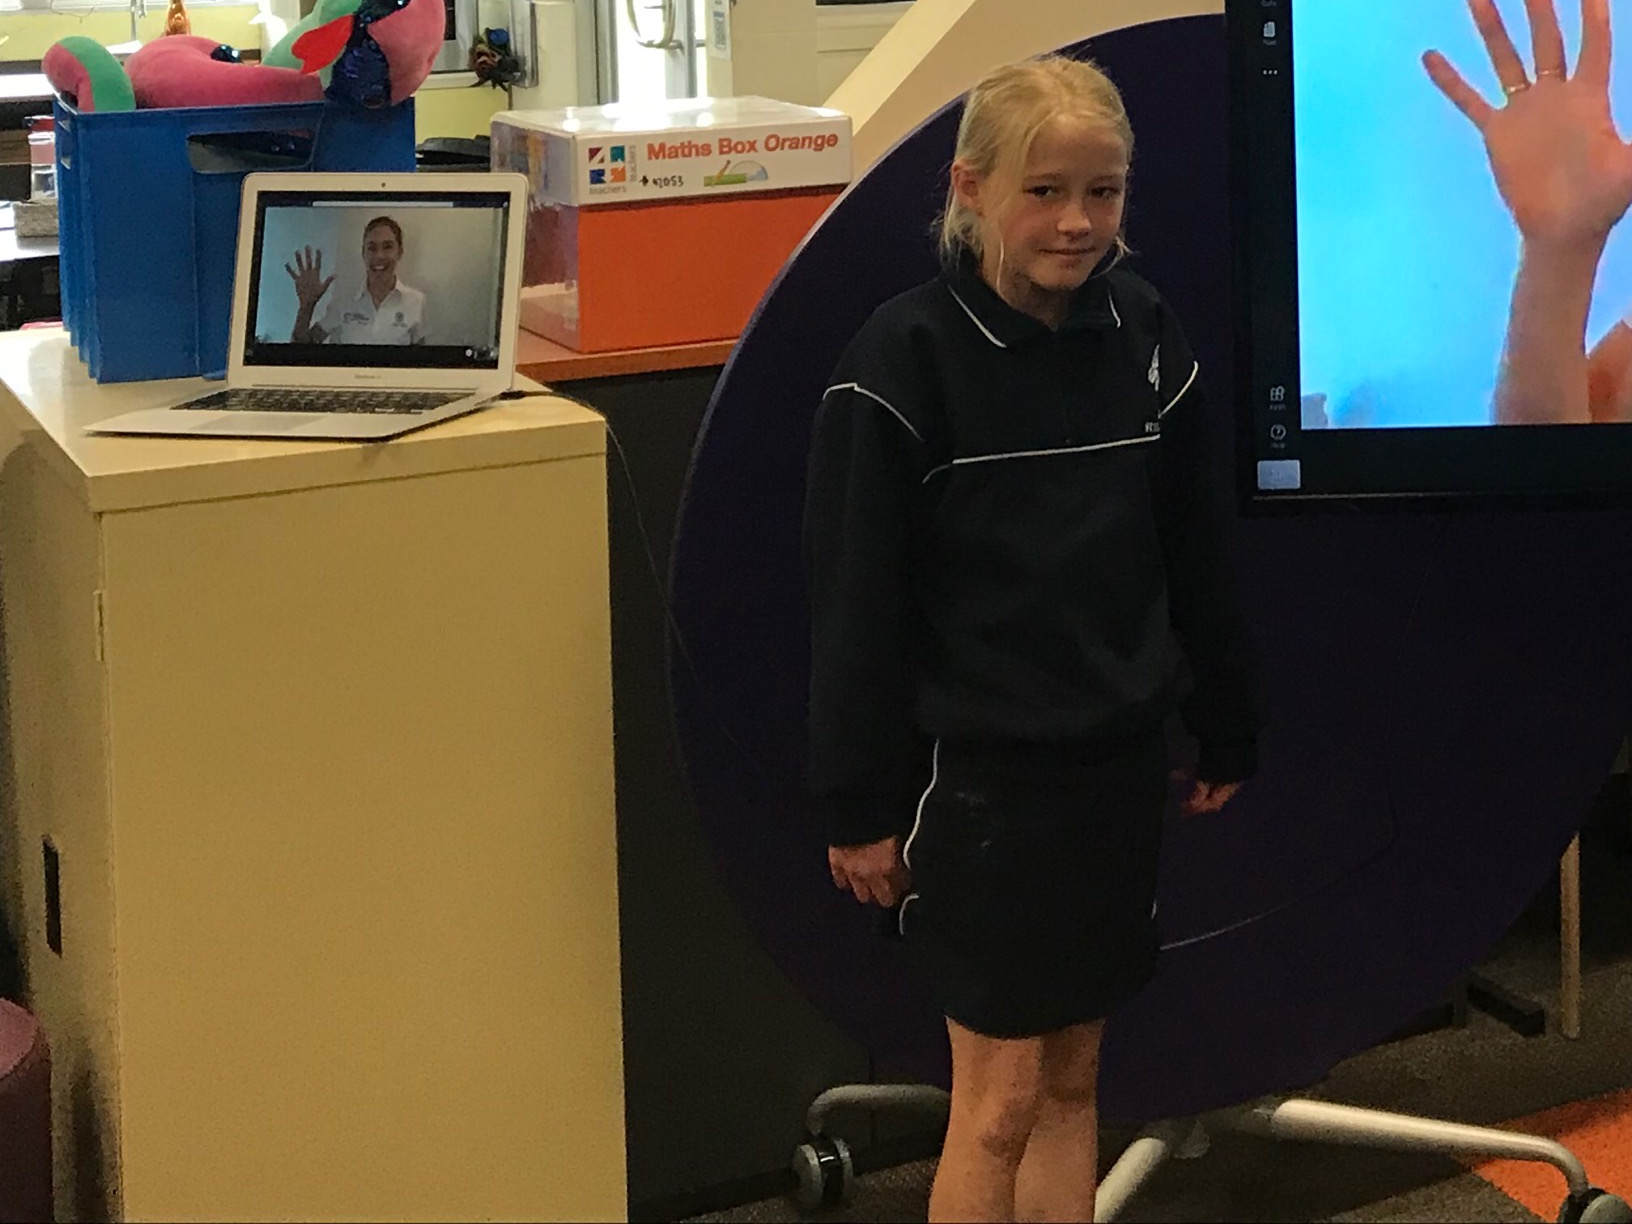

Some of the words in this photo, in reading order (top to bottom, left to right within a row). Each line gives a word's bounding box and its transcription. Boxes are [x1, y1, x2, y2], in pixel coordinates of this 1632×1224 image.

[646, 140, 712, 161] Maths
[718, 136, 757, 156] Box
[764, 132, 839, 152] Orange
